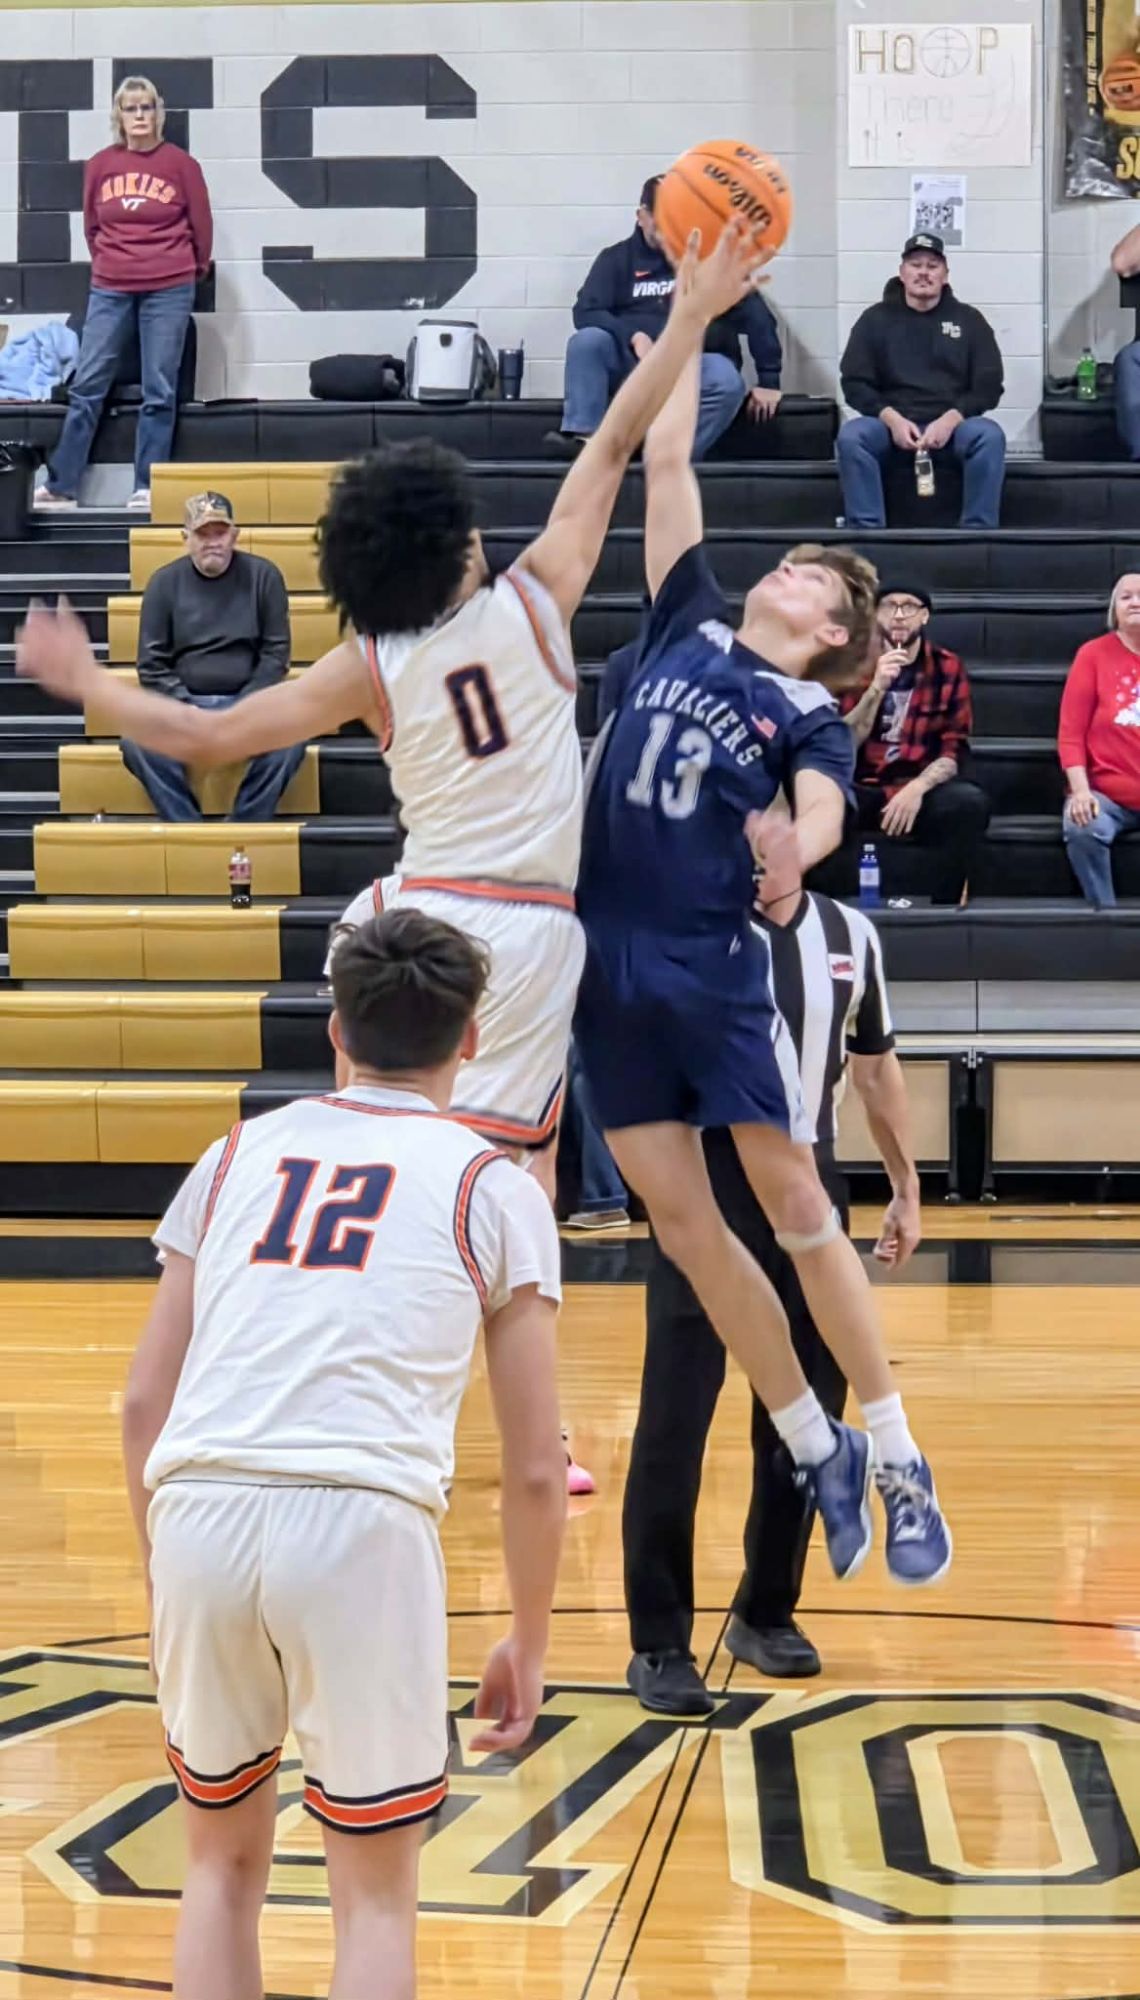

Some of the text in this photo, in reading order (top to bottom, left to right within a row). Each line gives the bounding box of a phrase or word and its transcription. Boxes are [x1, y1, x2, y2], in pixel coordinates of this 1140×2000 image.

[101, 172, 176, 204] HOKIES
[121, 197, 147, 212] VT
[444, 661, 510, 760] 0
[634, 677, 763, 767] CAVALIERS
[626, 712, 713, 819] 13
[249, 1157, 397, 1272] 12
